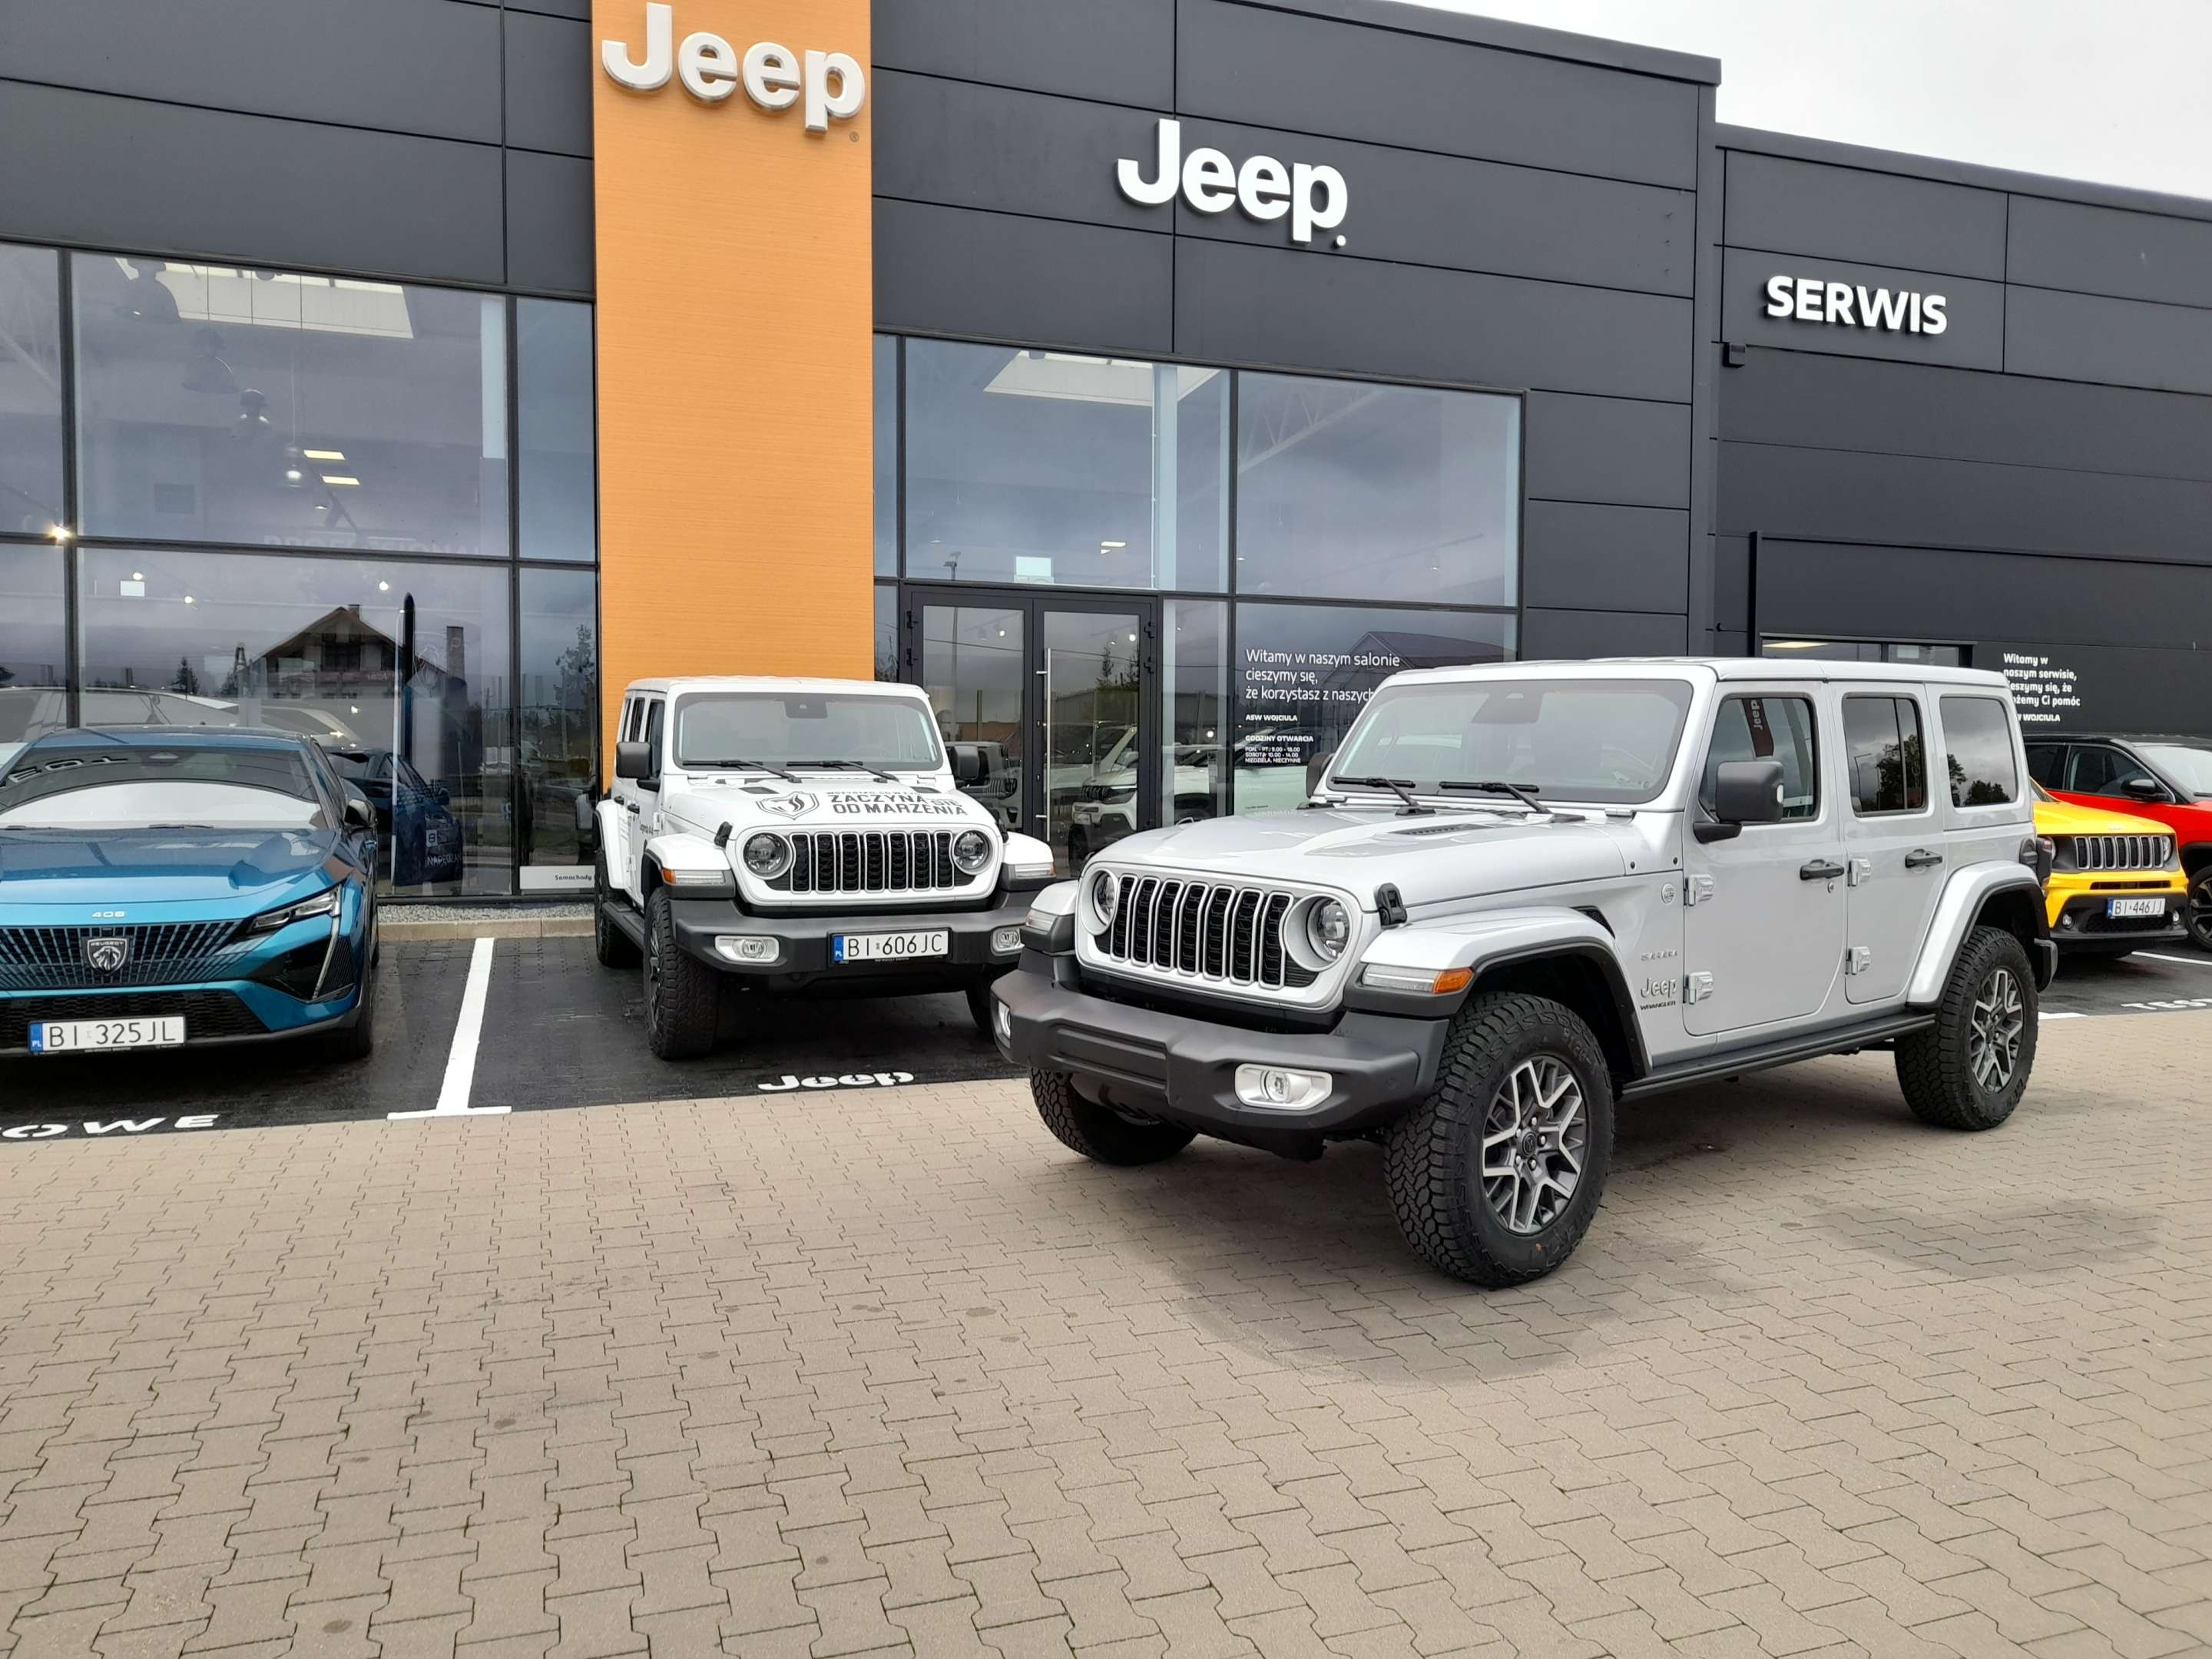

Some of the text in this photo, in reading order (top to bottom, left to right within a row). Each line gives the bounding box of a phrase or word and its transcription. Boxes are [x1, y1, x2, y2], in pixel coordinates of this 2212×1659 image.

[602, 2, 866, 135] Jeep
[1118, 118, 1348, 243] Jeep
[1767, 275, 1948, 335] SERWIS
[1245, 649, 1400, 667] Witamy w naszym salonie
[2003, 653, 2048, 667] Witamy w
[1245, 667, 1318, 684] cieszymy się,
[2003, 668, 2077, 681] naszym serwisie,
[1245, 686, 1374, 704] że korzystasz z naszych
[2045, 682, 2060, 694] się,
[2062, 682, 2072, 692] że
[2014, 694, 2081, 707] ożemy Ci pomóc
[827, 795, 929, 804] ZACZYNA
[833, 803, 969, 816] OD MARZENIA
[2114, 901, 2127, 915] BI
[848, 937, 869, 957] BI
[882, 933, 942, 955] 606JC
[1641, 978, 1677, 998] Jeep
[1640, 1000, 1676, 1011] WRANGLER
[49, 1025, 78, 1048] BI
[95, 1021, 176, 1045] 325JL
[757, 1071, 915, 1091] Jeep
